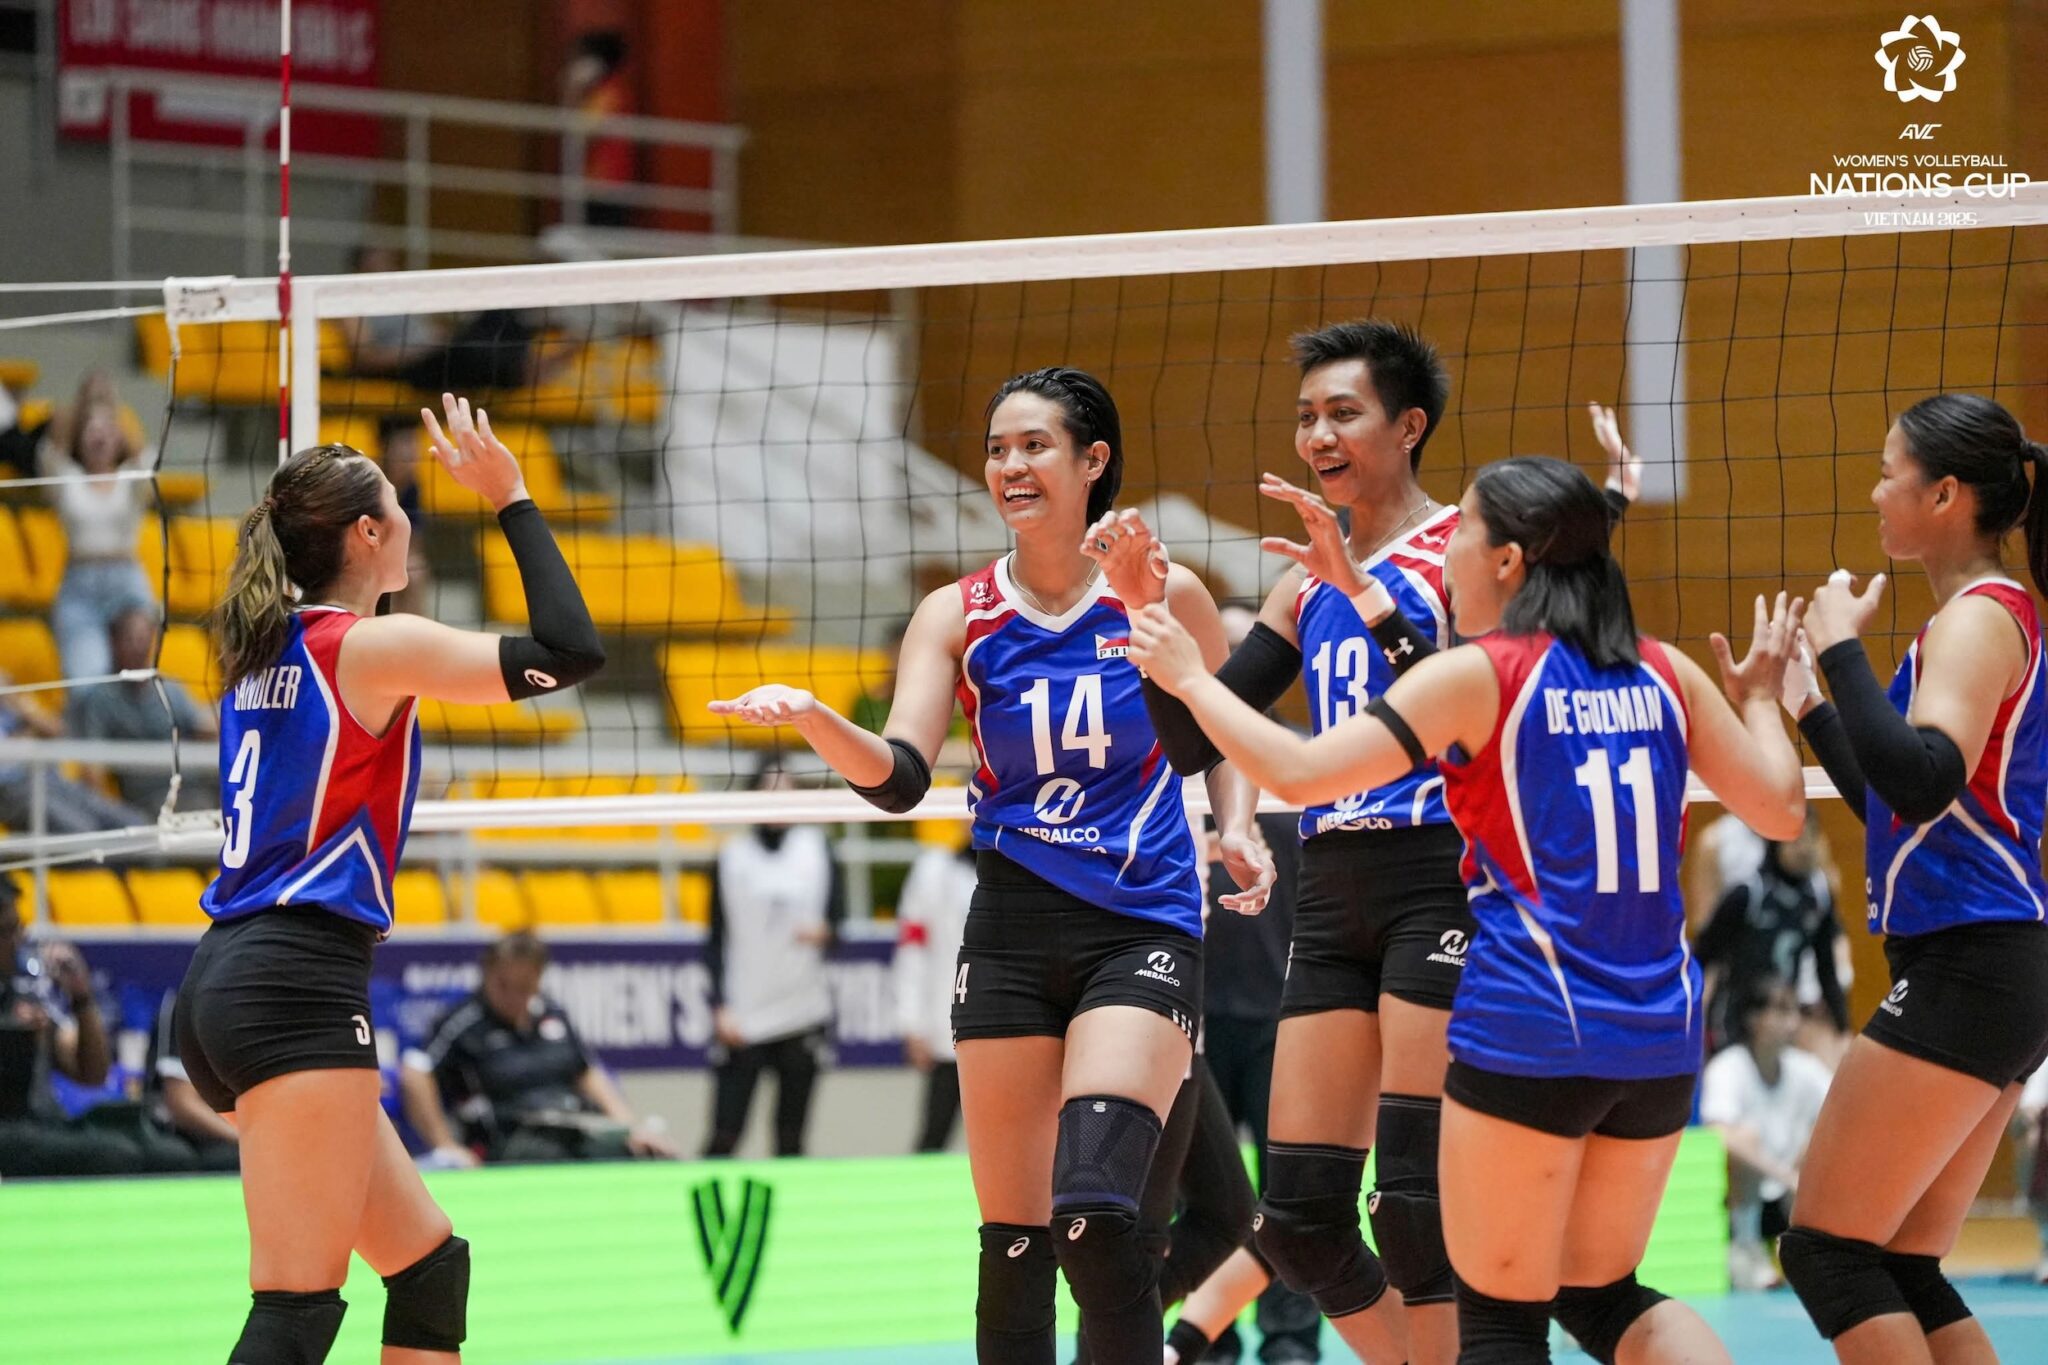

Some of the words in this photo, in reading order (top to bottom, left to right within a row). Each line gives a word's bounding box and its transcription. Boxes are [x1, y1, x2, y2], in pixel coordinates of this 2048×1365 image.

[1020, 673, 1112, 776] 14
[1311, 636, 1370, 737] 13
[1543, 687, 1574, 735] DE
[1572, 685, 1663, 735] GUZMAN
[222, 729, 261, 869] 3
[1574, 746, 1660, 893] 11
[1134, 969, 1181, 988] MERALCO
[1426, 952, 1467, 967] MERALC
